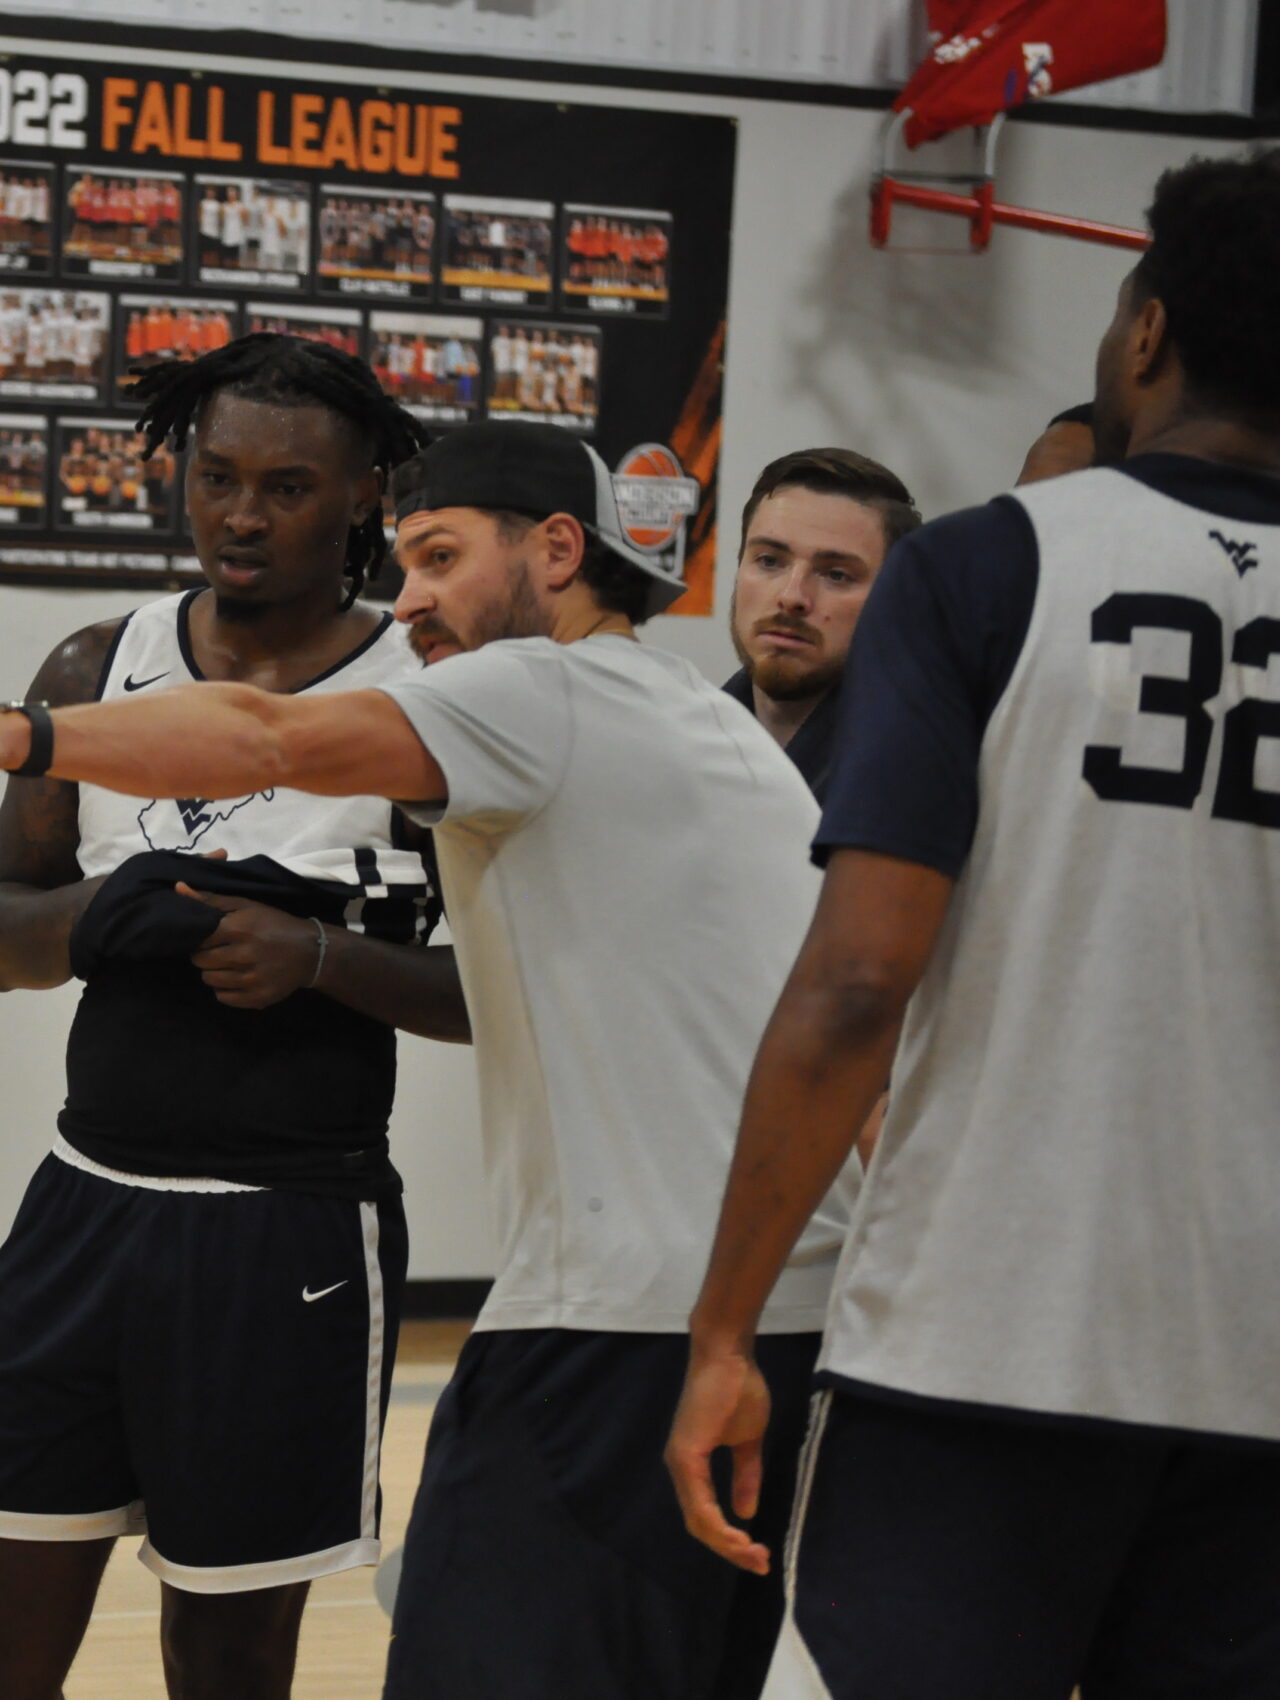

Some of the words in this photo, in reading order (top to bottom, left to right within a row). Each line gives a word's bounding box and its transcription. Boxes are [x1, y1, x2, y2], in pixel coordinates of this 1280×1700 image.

[102, 77, 242, 162] FALL
[257, 90, 462, 179] LEAGUE
[1081, 591, 1280, 832] 32
